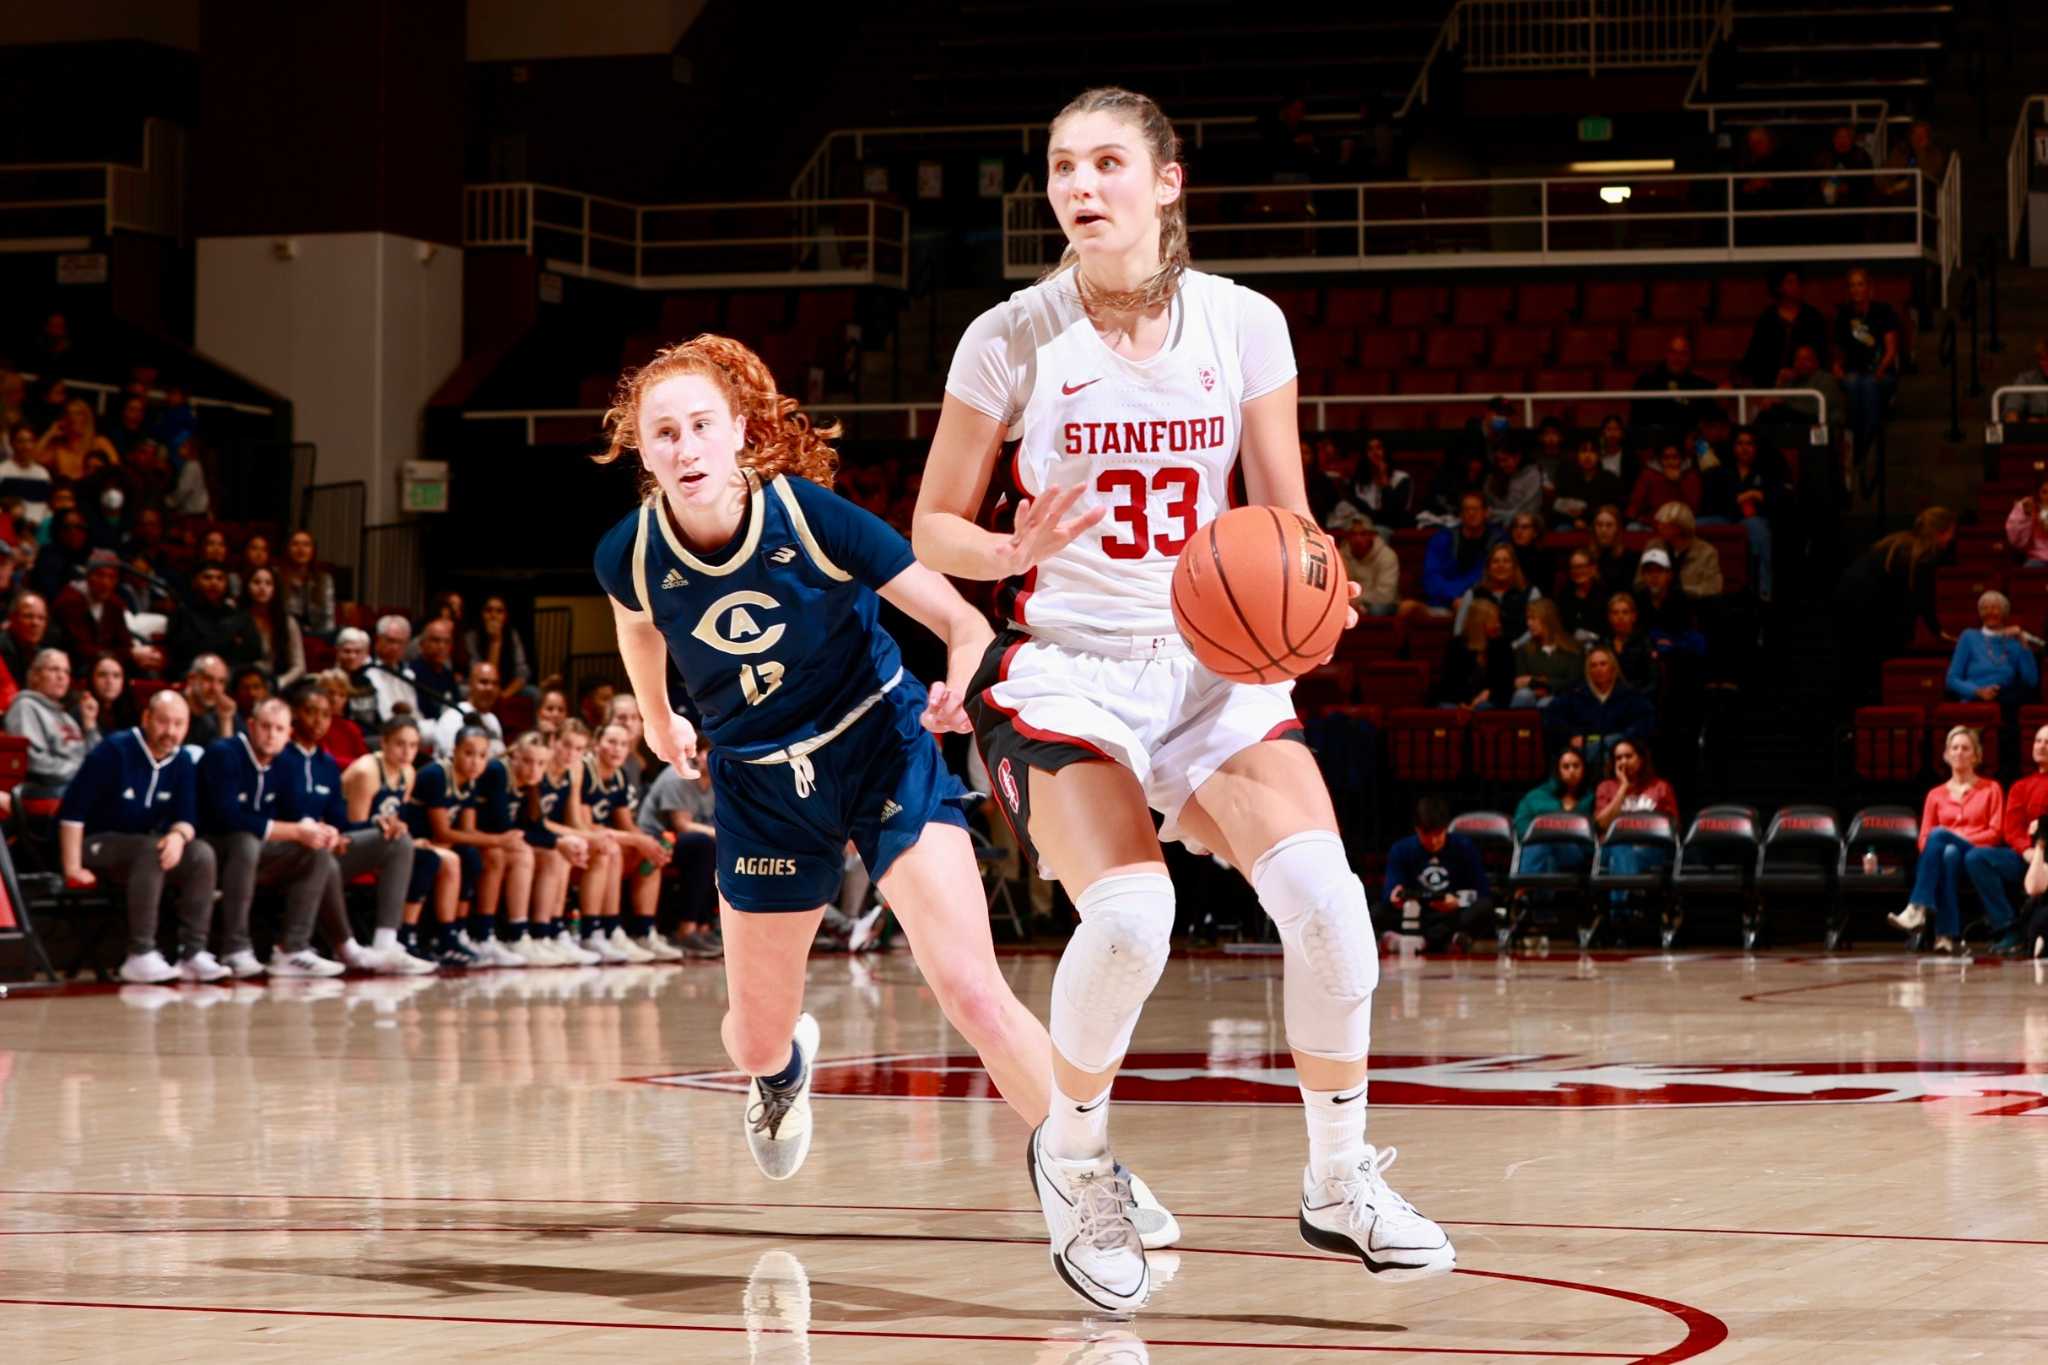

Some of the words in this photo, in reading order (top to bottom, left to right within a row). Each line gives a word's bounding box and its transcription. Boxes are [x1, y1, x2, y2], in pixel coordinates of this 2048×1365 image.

[1064, 416, 1224, 454] STANFORD
[1096, 467, 1200, 560] 33
[661, 579, 689, 590] adidas
[734, 856, 797, 876] AGGIES
